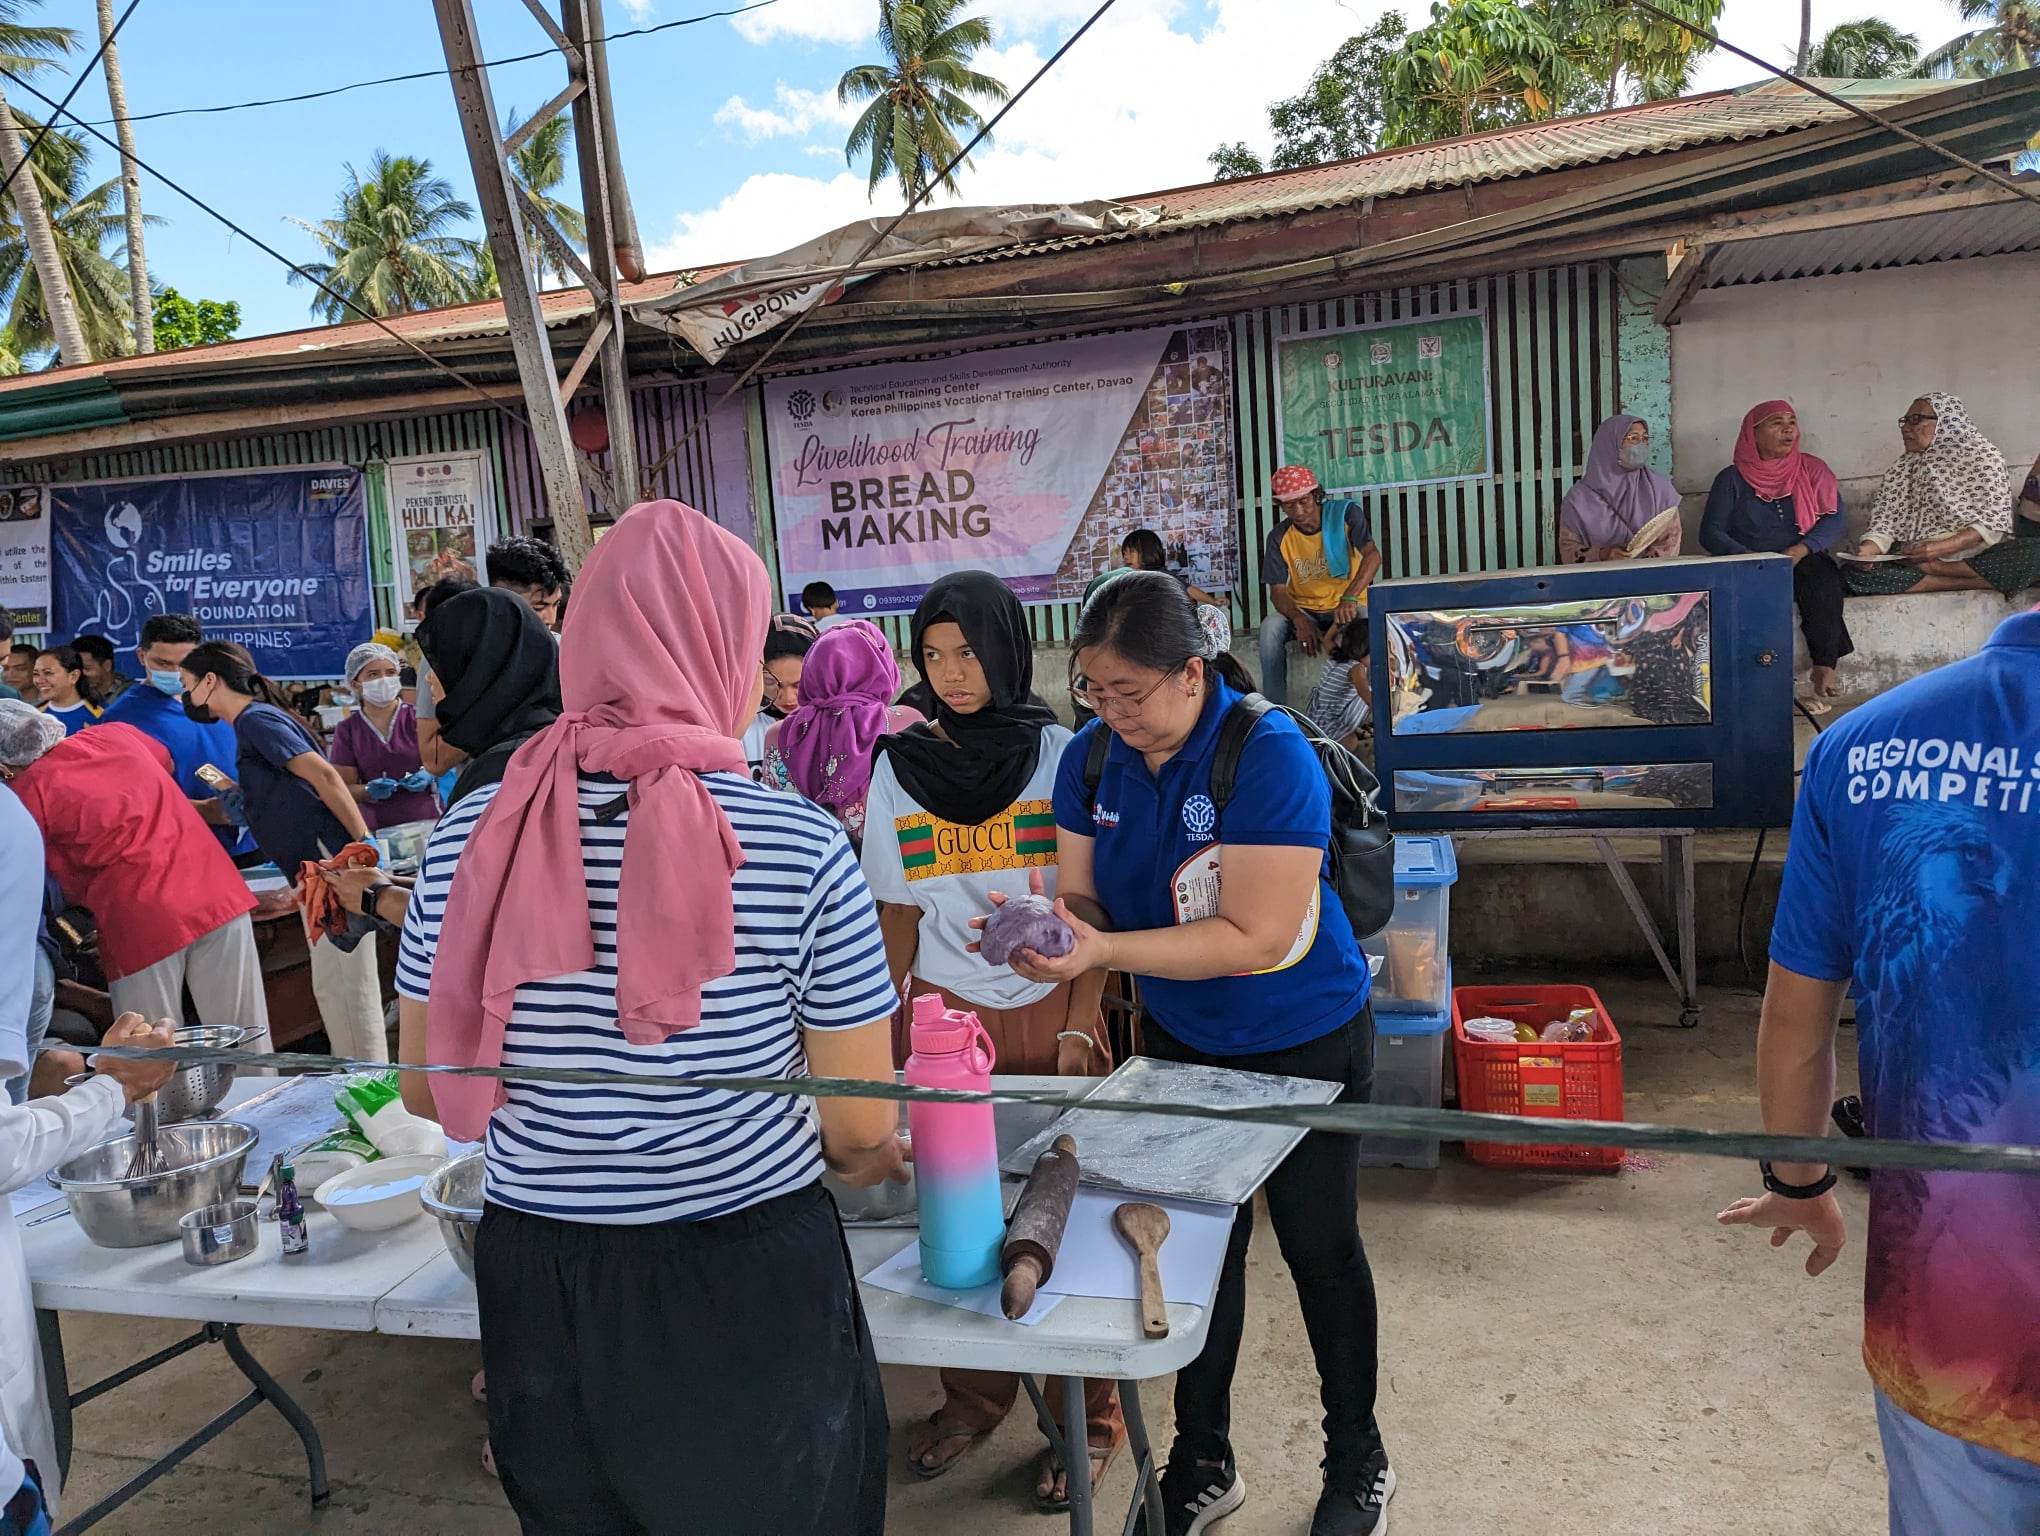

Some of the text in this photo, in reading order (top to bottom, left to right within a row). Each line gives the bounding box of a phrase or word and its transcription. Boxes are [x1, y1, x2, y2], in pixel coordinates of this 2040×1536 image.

[851, 359, 1072, 393] Technical Education and Skills Development Authority
[1328, 370, 1433, 393] KULTURAVAN:
[850, 382, 980, 405] Regional Training Center
[851, 376, 1133, 418] Korea Philippines Vocational Training Center, Davao
[1318, 416, 1453, 460] TESDA
[794, 417, 1042, 487] Livelihood Training
[311, 478, 350, 490] DAVIES
[830, 468, 976, 513] BREAD
[405, 493, 468, 508] PEKENG DENTISTA
[402, 503, 475, 528] HULI KA!
[821, 503, 991, 550] MAKING
[5, 544, 46, 556] utilize the
[146, 548, 233, 573] Smiles
[13, 560, 47, 570] of the
[0, 574, 47, 585] ithin Eastern
[164, 574, 319, 603] for Everyone
[10, 612, 41, 624] Center
[192, 604, 296, 620] FOUNDATION
[1848, 738, 2025, 779] REGIONAL
[1847, 769, 2040, 813] COMPETI
[937, 822, 1014, 856] GUCCI
[1186, 833, 1215, 841] TESDA
